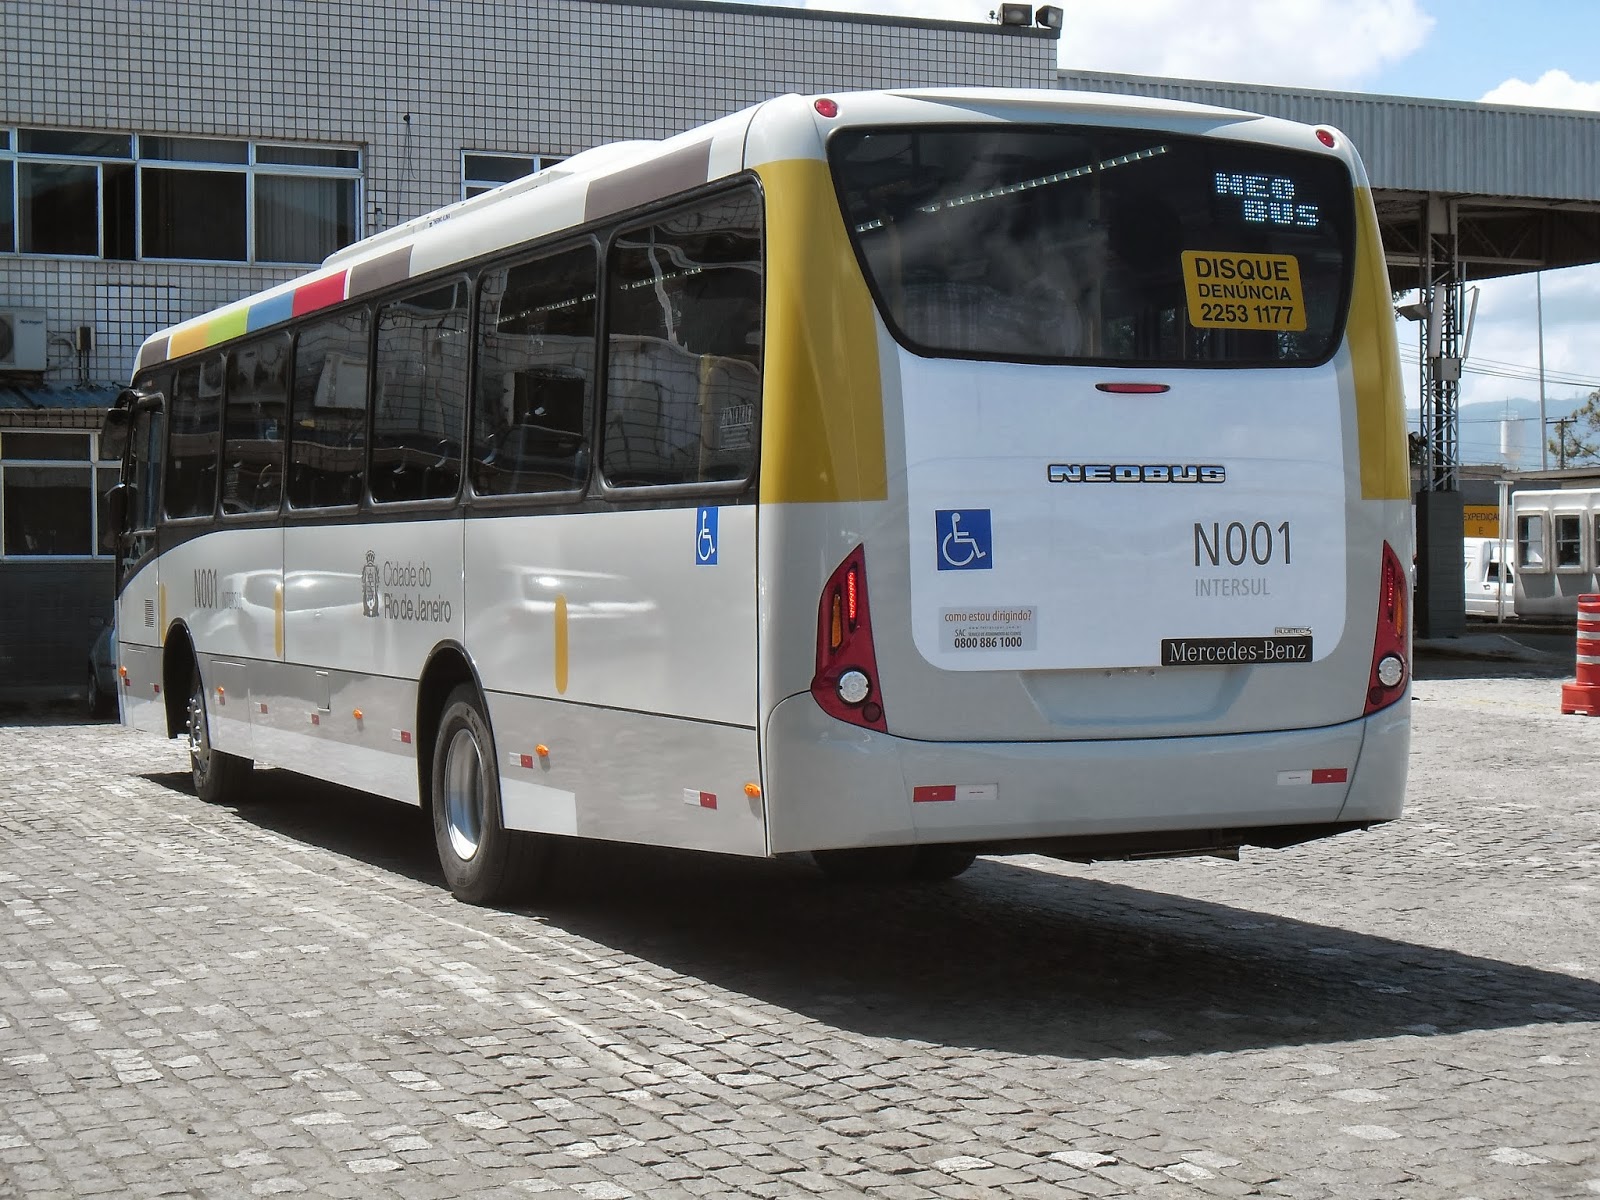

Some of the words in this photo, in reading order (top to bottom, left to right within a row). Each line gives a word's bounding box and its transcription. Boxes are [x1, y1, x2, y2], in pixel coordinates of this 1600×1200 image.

[1216, 172, 1295, 200] NEO
[1244, 200, 1320, 226] BUS
[1195, 257, 1290, 281] DISQUE
[1198, 281, 1292, 300] DENÚNCIA
[1200, 302, 1248, 322] 2253
[1254, 304, 1294, 324] 1177
[1048, 464, 1226, 483] NEOBUS
[1194, 521, 1290, 566] N001
[384, 561, 416, 587] Cidade
[418, 561, 432, 588] do
[194, 568, 218, 609] N001
[1195, 578, 1271, 597] INTERSUL
[384, 592, 399, 620] Rio
[400, 594, 413, 620] de
[414, 594, 452, 623] Janeiro
[944, 612, 966, 622] como
[968, 612, 990, 622] estou
[992, 610, 1032, 624] dirigindo?
[954, 638, 978, 648] 0800
[980, 637, 997, 648] 886
[1000, 636, 1022, 647] 1000
[1169, 640, 1306, 662] Mercedes-Benz
